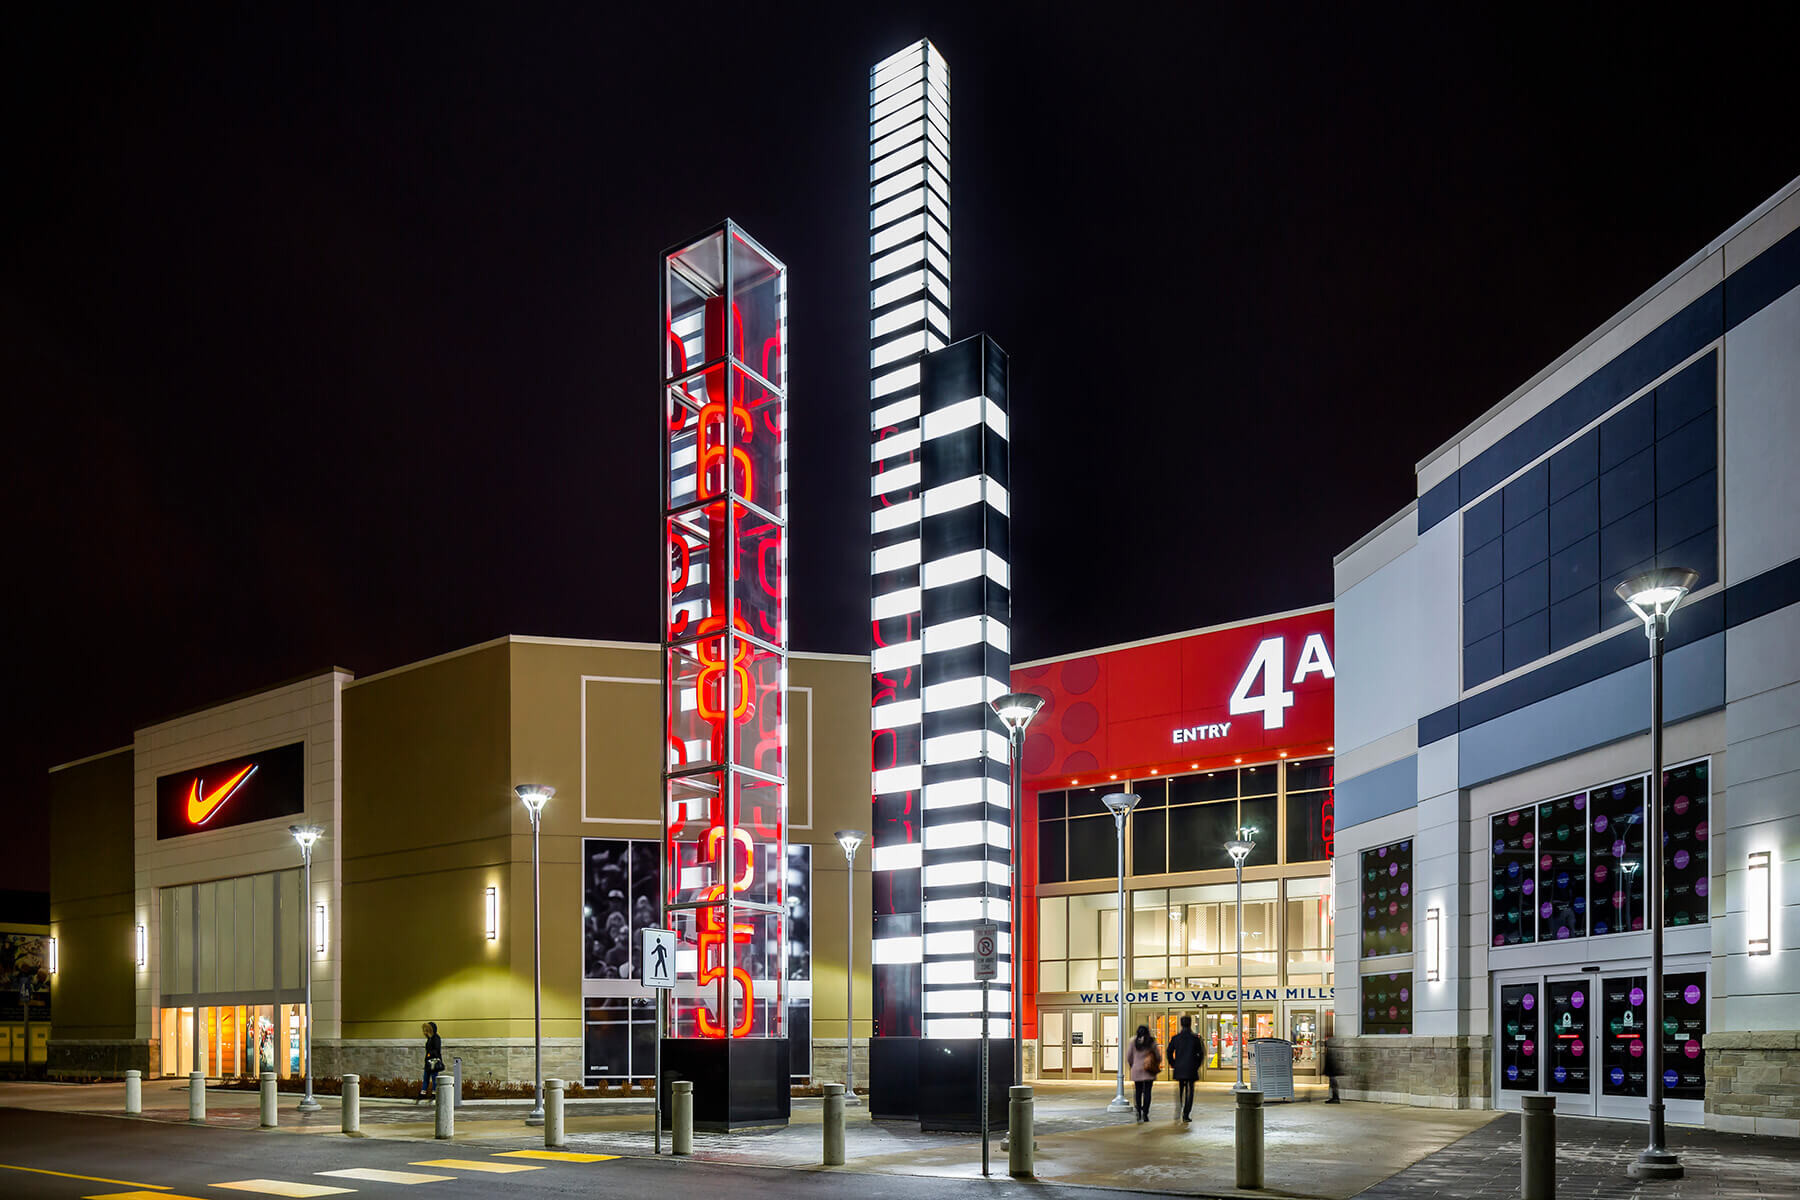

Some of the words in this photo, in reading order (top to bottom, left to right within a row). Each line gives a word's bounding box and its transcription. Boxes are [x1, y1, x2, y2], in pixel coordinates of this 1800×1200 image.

[696, 615, 756, 724] 8
[1172, 721, 1232, 744] ENTRY
[697, 931, 755, 1038] 5
[1164, 991, 1185, 1002] TO
[1191, 988, 1277, 1001] VAUGHAN
